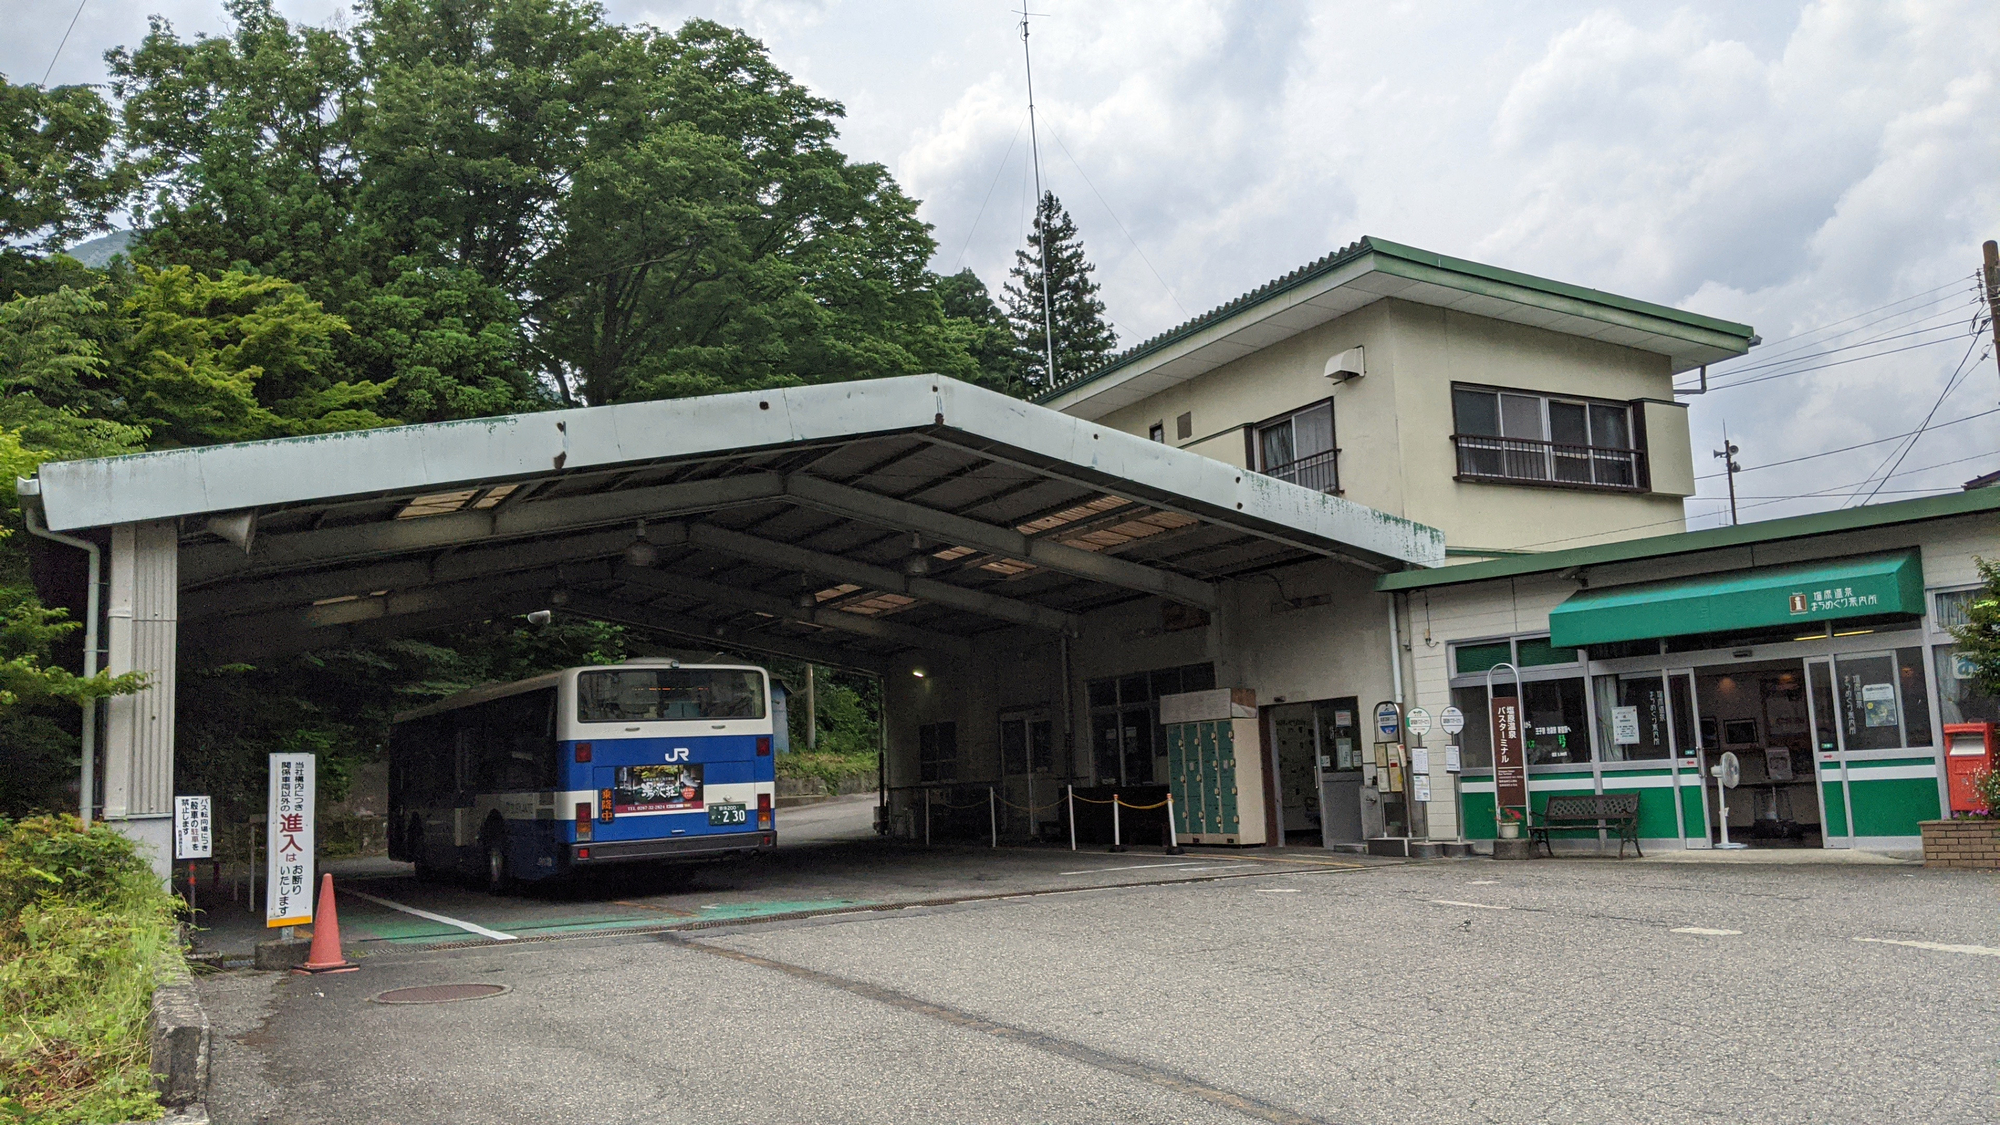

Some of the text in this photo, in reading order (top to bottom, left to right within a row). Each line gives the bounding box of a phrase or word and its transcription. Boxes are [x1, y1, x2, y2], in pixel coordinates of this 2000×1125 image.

[1811, 594, 1878, 612] まちめぐり案内所
[1813, 587, 1853, 601] 塩原温泉
[1498, 706, 1510, 764] バスターミナル
[1506, 705, 1518, 739] 塩原温泉
[664, 747, 690, 762] JR
[280, 761, 291, 812] 関係車両以外の
[294, 761, 304, 812] 当社構内につき
[181, 799, 190, 836] 禁止します
[279, 866, 290, 916] いたします
[292, 864, 303, 895] お断り
